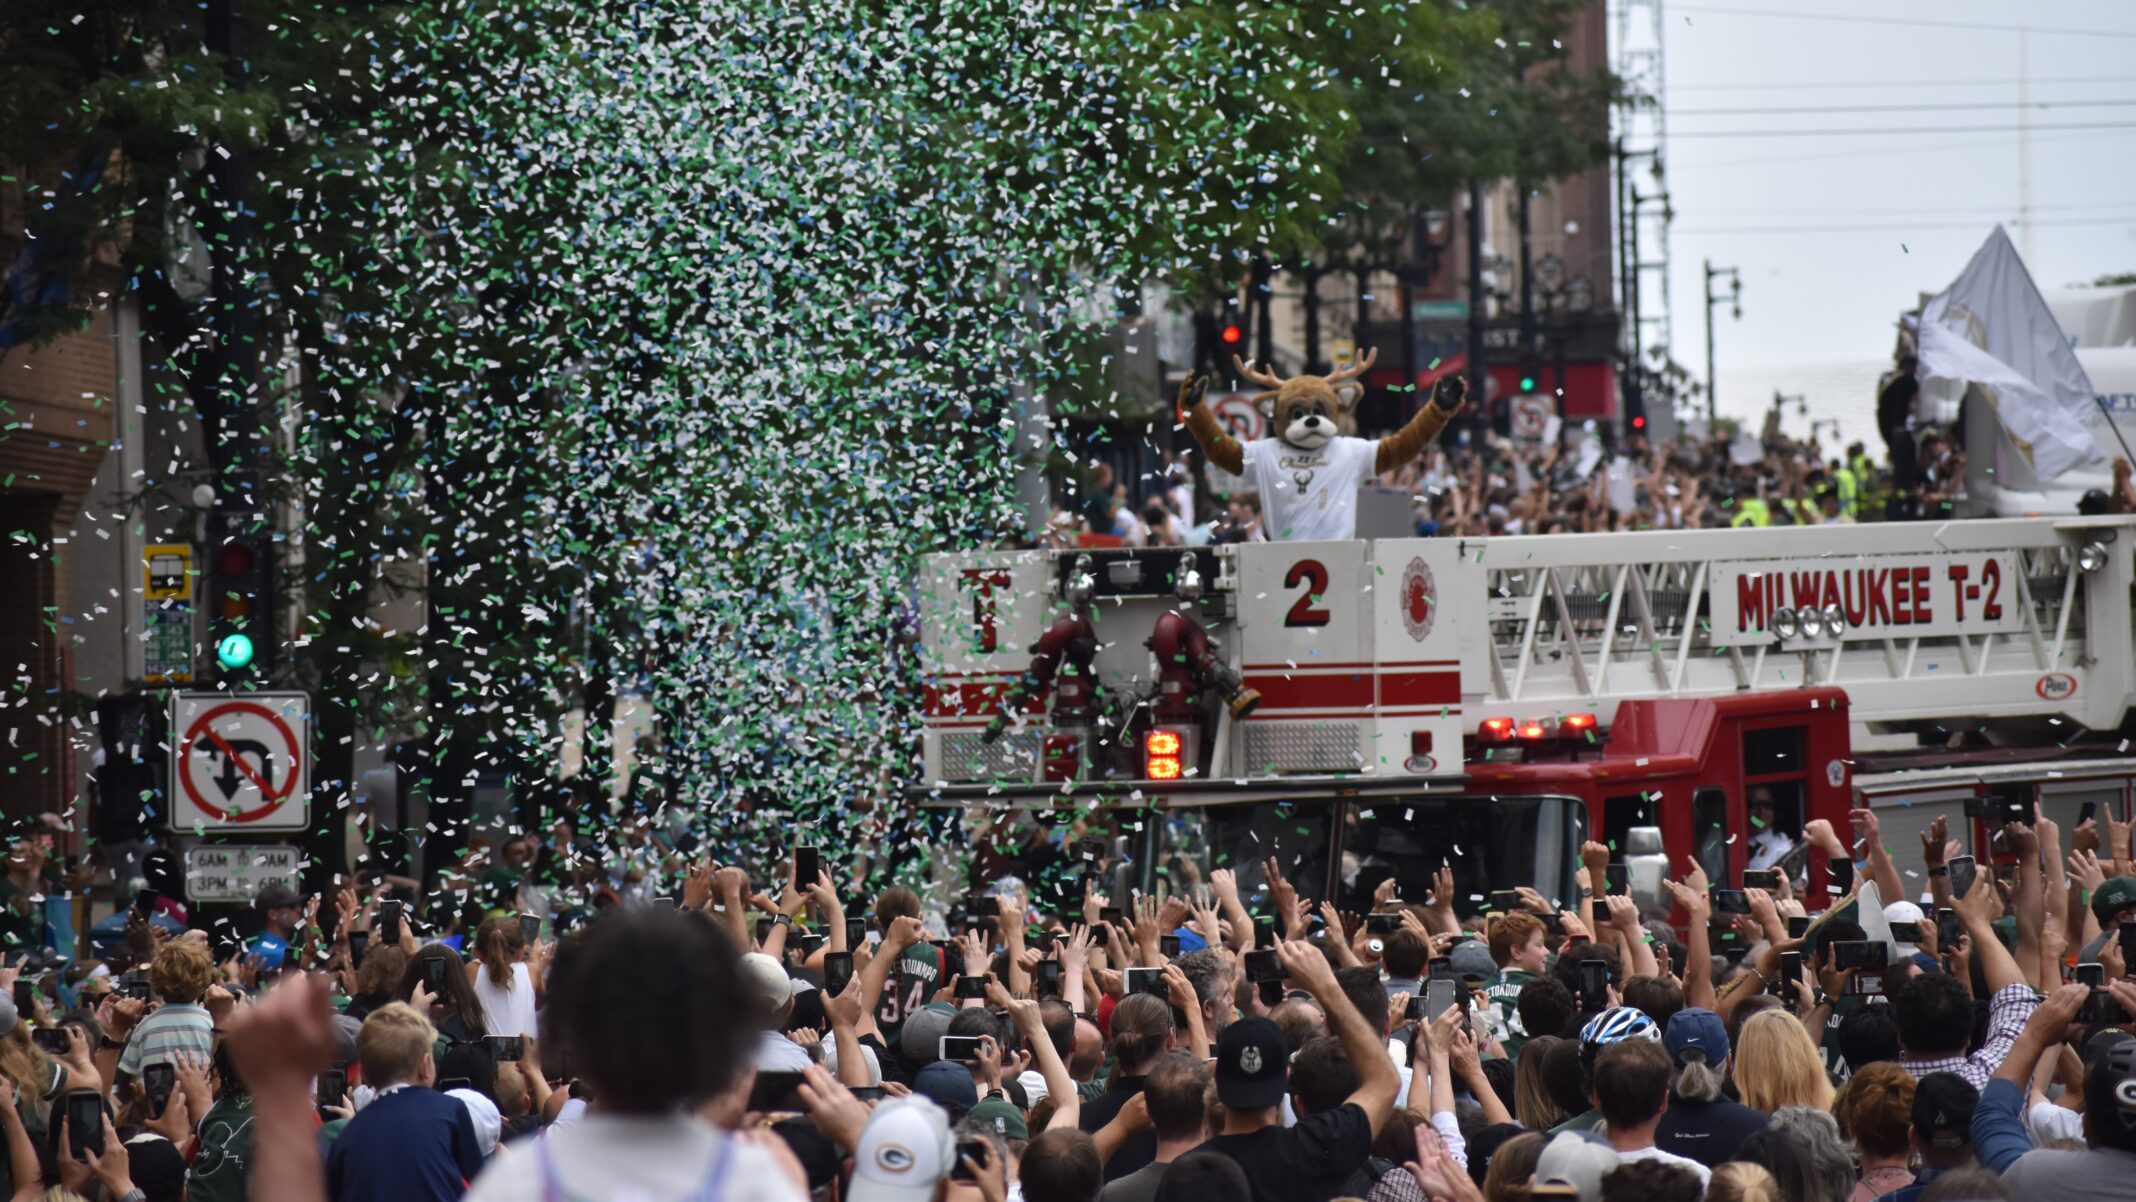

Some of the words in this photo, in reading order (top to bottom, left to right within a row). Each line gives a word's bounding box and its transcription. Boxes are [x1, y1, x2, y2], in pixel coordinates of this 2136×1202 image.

[957, 568, 1011, 654] T
[1284, 559, 1331, 628] 2
[1737, 566, 1932, 633] MILWAUKEE
[1948, 558, 2002, 622] T-2
[198, 877, 227, 891] 3PM
[199, 853, 228, 866] 6AM
[881, 978, 923, 1023] 34
